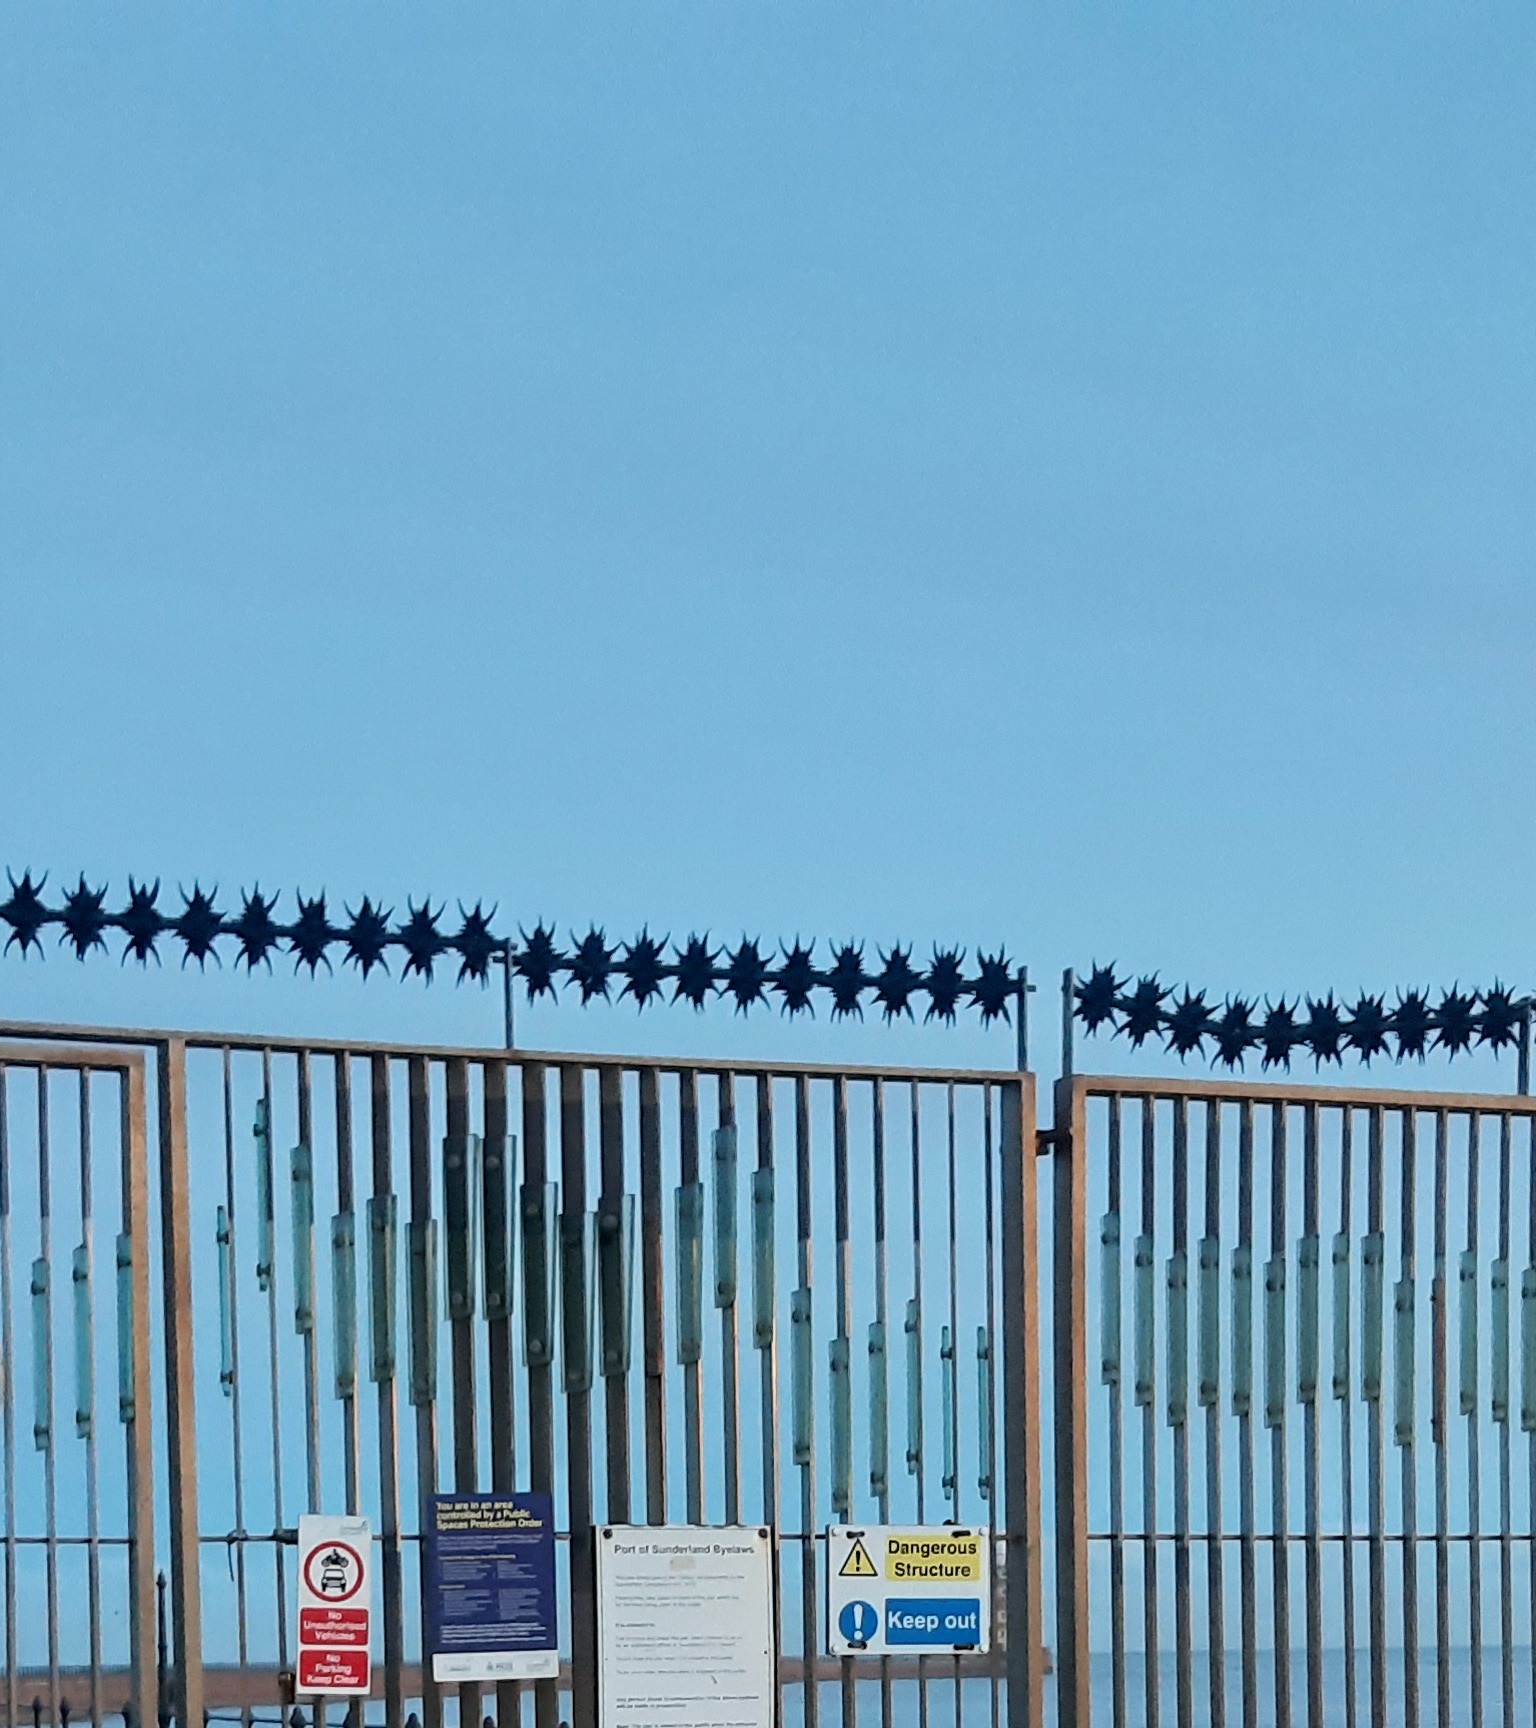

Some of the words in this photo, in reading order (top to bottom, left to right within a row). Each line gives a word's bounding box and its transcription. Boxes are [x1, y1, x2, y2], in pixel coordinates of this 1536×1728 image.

[470, 1519, 517, 1529] Protection
[518, 1519, 543, 1528] Order
[614, 1544, 636, 1554] Port
[639, 1544, 649, 1554] of
[652, 1544, 711, 1554] Sunderland
[714, 1544, 755, 1556] Byelaws
[888, 1539, 977, 1558] Dangerous
[894, 1562, 971, 1577] Structure
[327, 1611, 342, 1620] No
[888, 1611, 939, 1633] Keep
[944, 1612, 977, 1629] out
[314, 1631, 356, 1641] Vehicles
[326, 1653, 341, 1663] No
[315, 1663, 352, 1675] Parking
[306, 1674, 332, 1686] Keep
[333, 1674, 360, 1684] Clear
